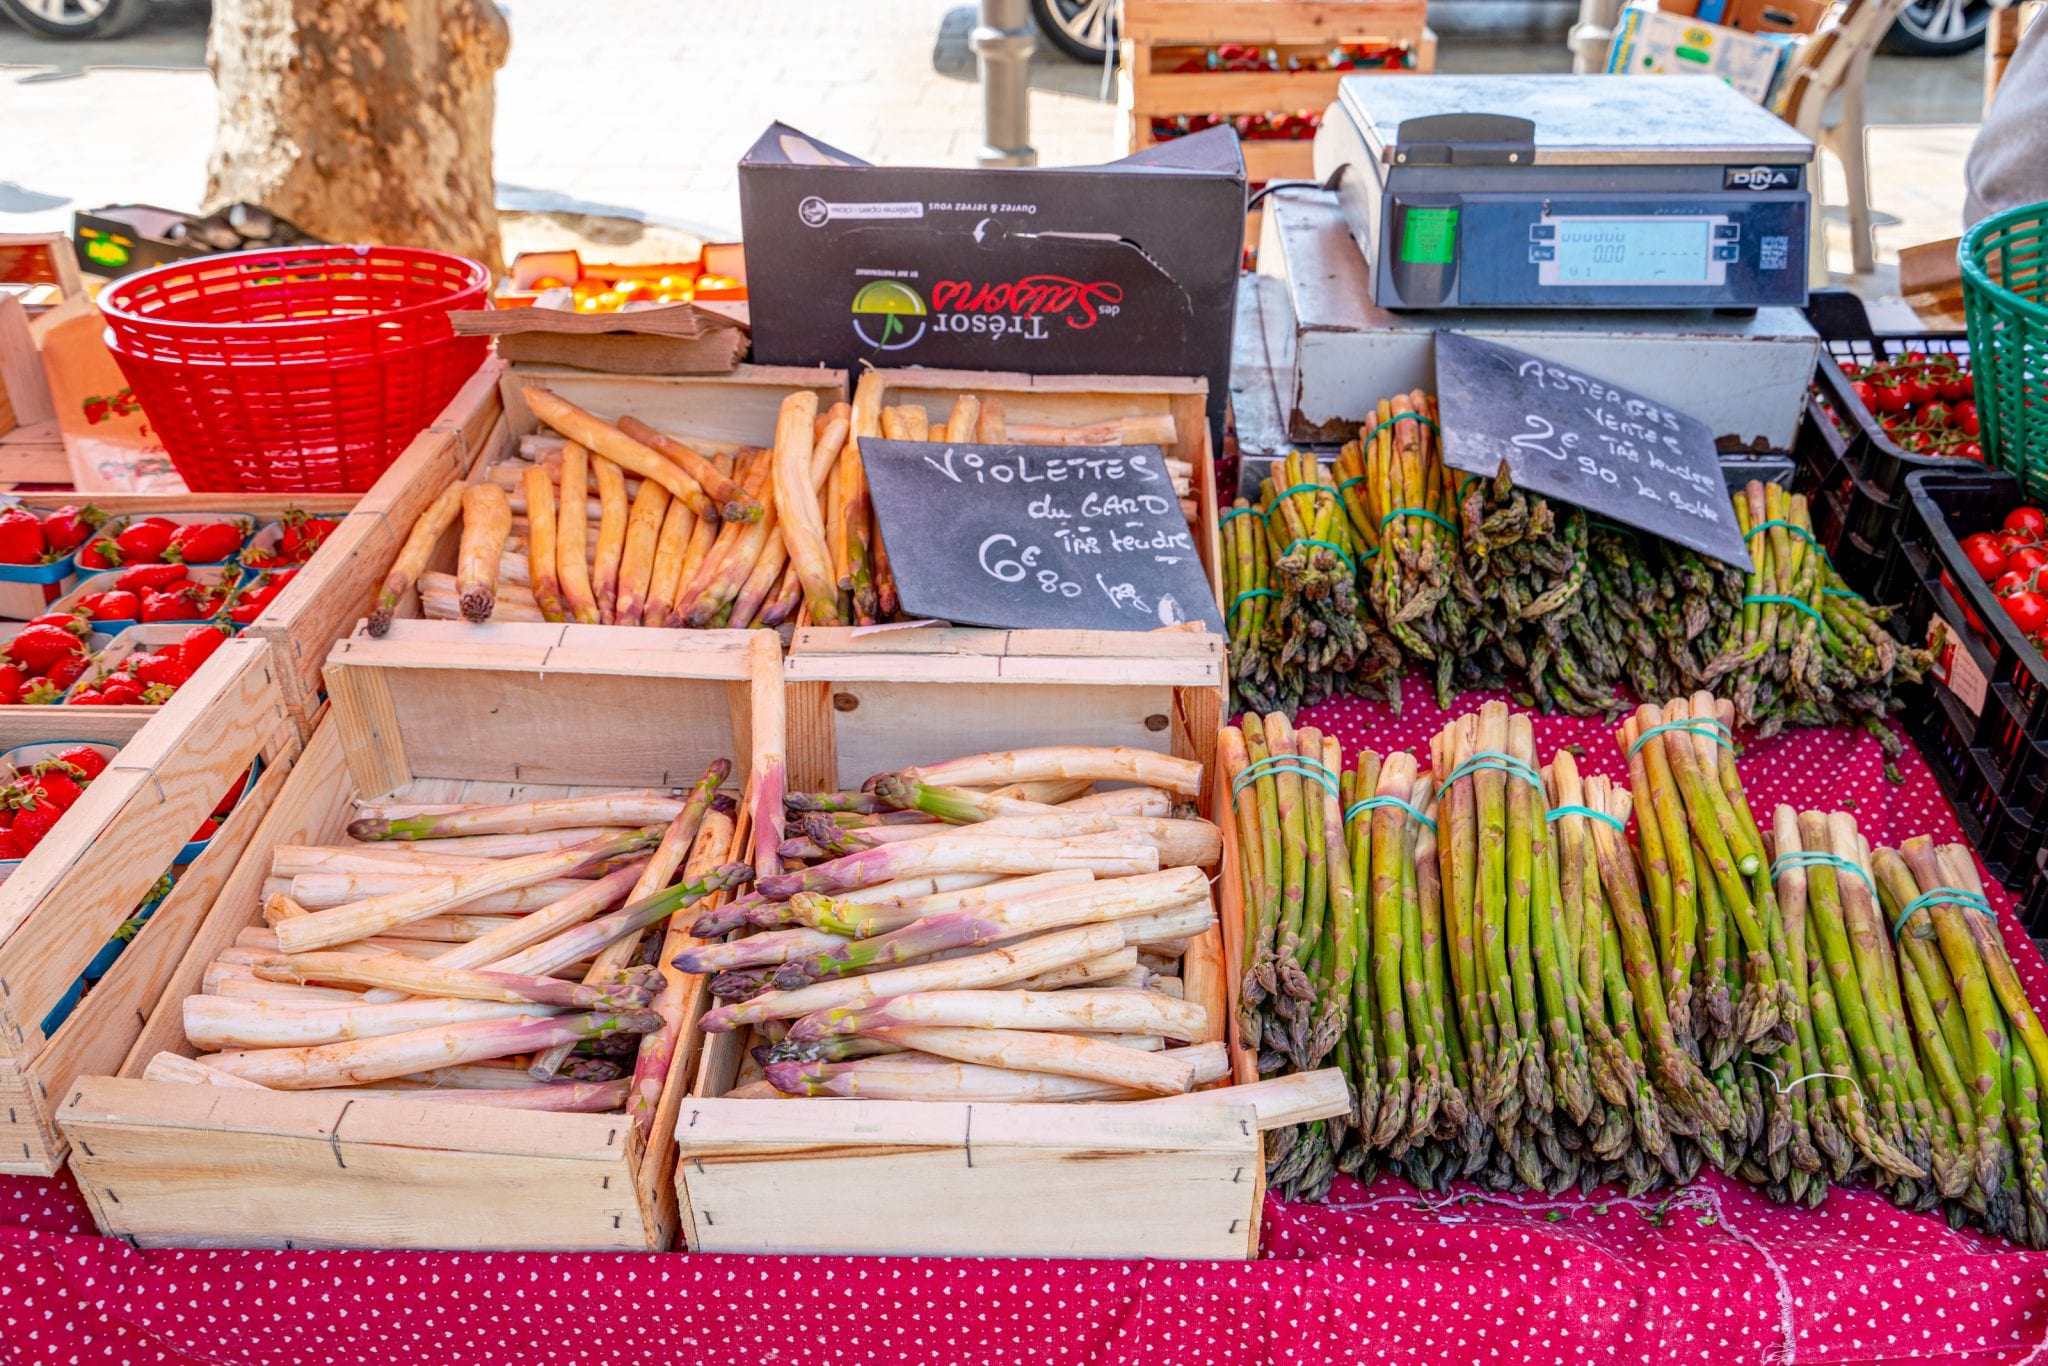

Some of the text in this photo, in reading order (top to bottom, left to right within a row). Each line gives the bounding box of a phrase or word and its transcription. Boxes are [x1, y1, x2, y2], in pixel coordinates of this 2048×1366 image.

[1733, 172, 1789, 184] DINA
[929, 202, 1037, 215] Ouvrez & servez vous
[932, 274, 1123, 330] des Saisons
[933, 313, 1049, 340] Trésor
[1028, 494, 1072, 519] du
